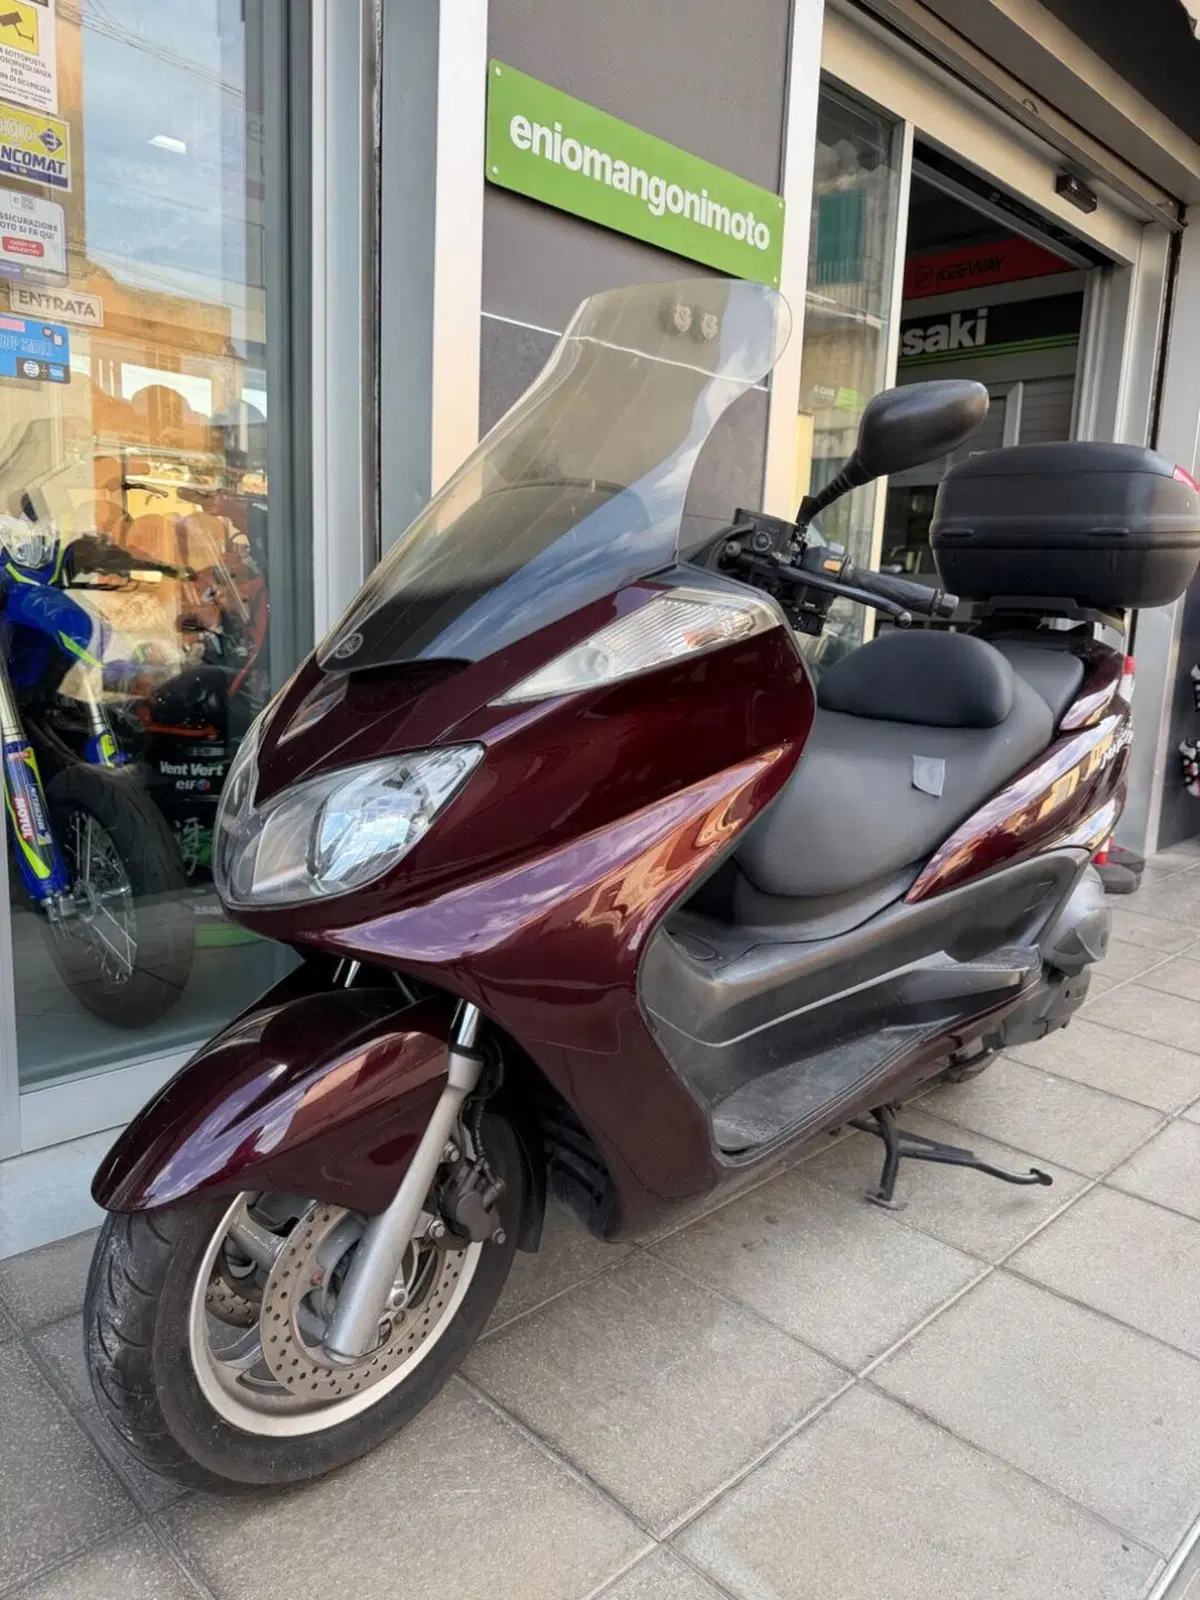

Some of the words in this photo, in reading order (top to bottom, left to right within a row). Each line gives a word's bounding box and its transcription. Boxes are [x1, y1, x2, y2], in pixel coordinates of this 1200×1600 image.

[1, 145, 66, 175] NCOMAT
[509, 115, 770, 250] eniomangonimoto
[19, 288, 96, 318] ENTRATA
[900, 308, 988, 356] saki
[160, 760, 188, 776] Vent
[190, 763, 224, 776] Vert
[175, 779, 196, 790] elf
[14, 798, 34, 840] MOTUL
